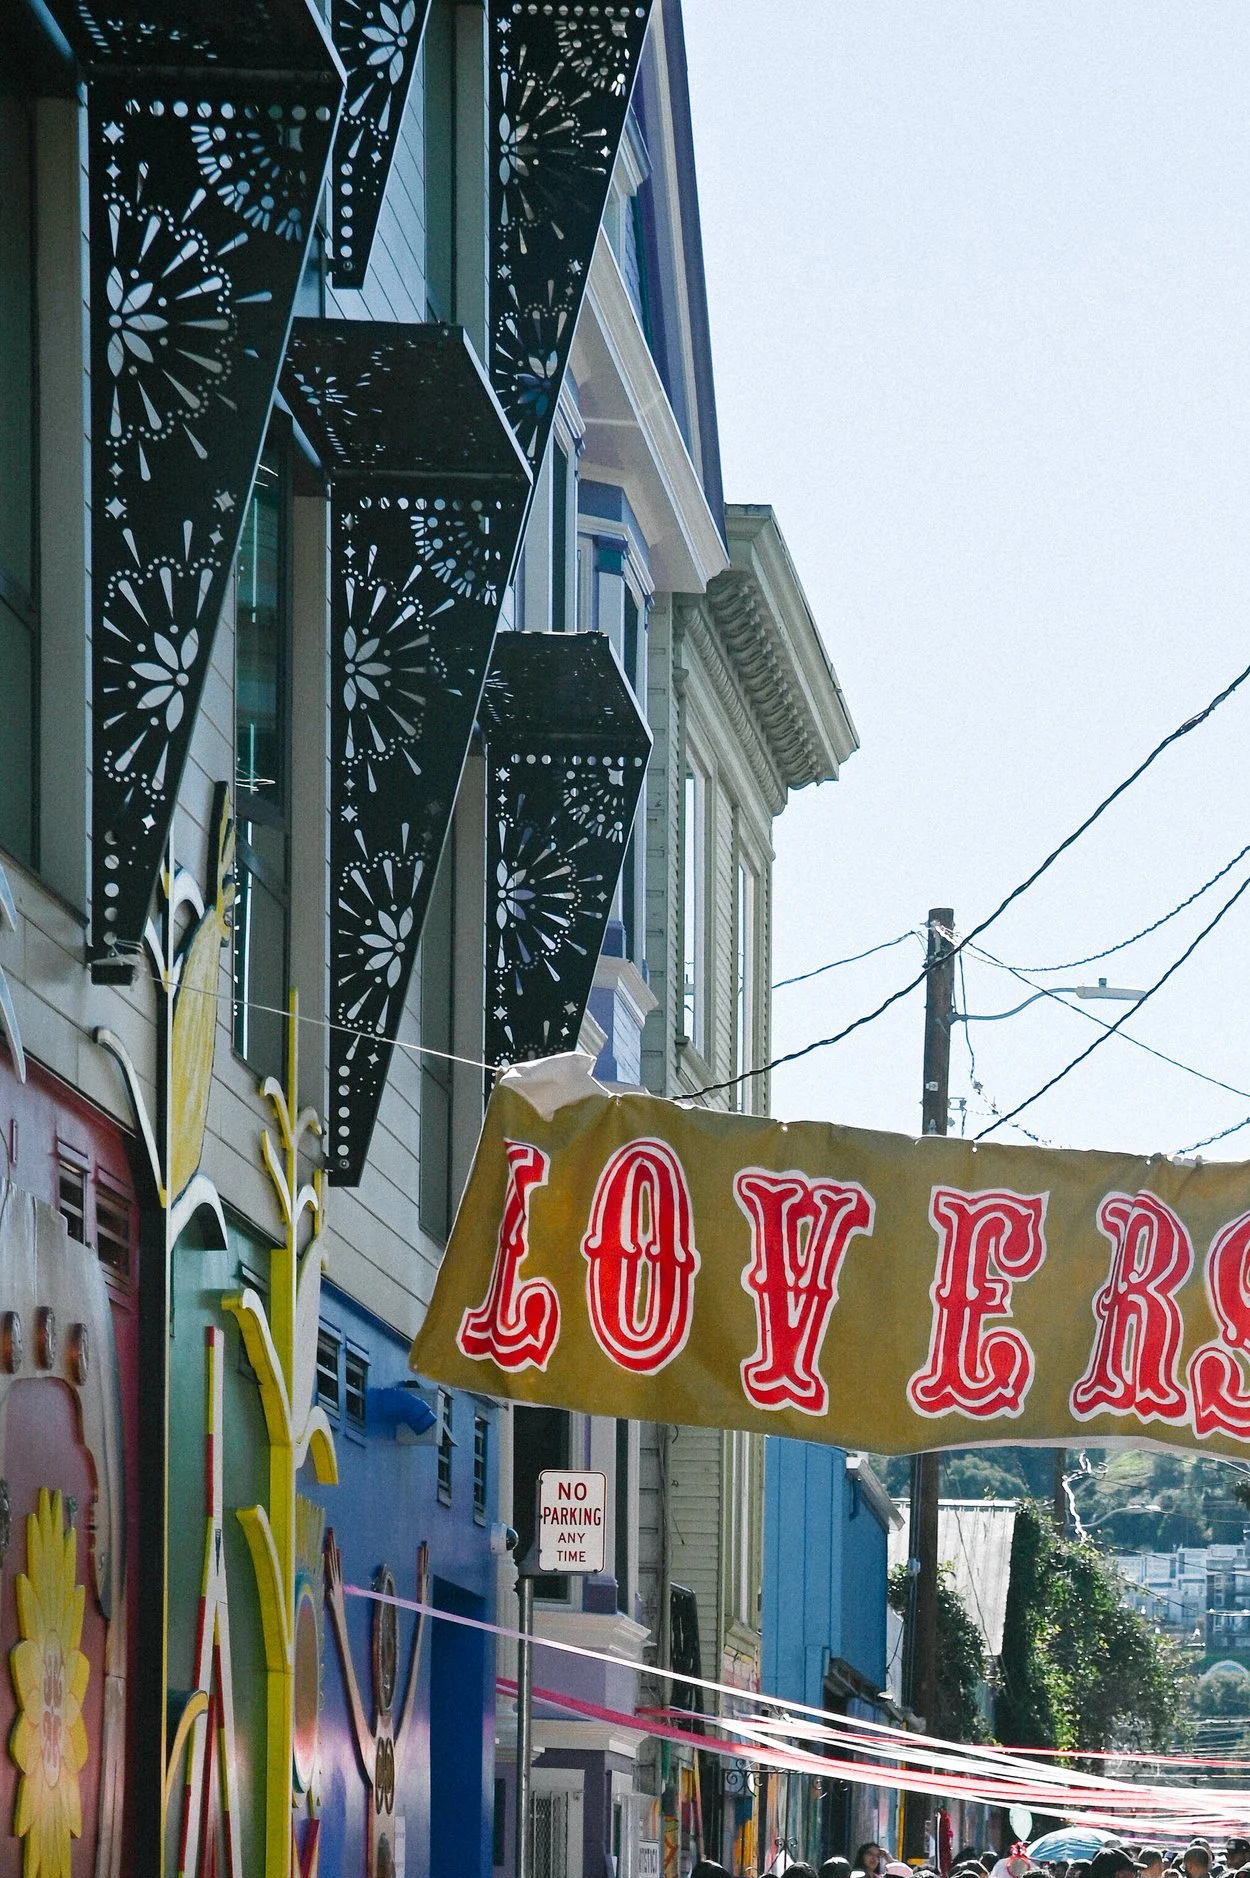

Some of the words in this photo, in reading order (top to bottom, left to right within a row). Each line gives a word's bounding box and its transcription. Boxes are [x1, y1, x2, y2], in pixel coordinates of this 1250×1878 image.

[558, 1482, 587, 1501] NO
[543, 1506, 601, 1526] PARKING
[557, 1532, 586, 1544] ANY
[556, 1550, 586, 1562] TIME
